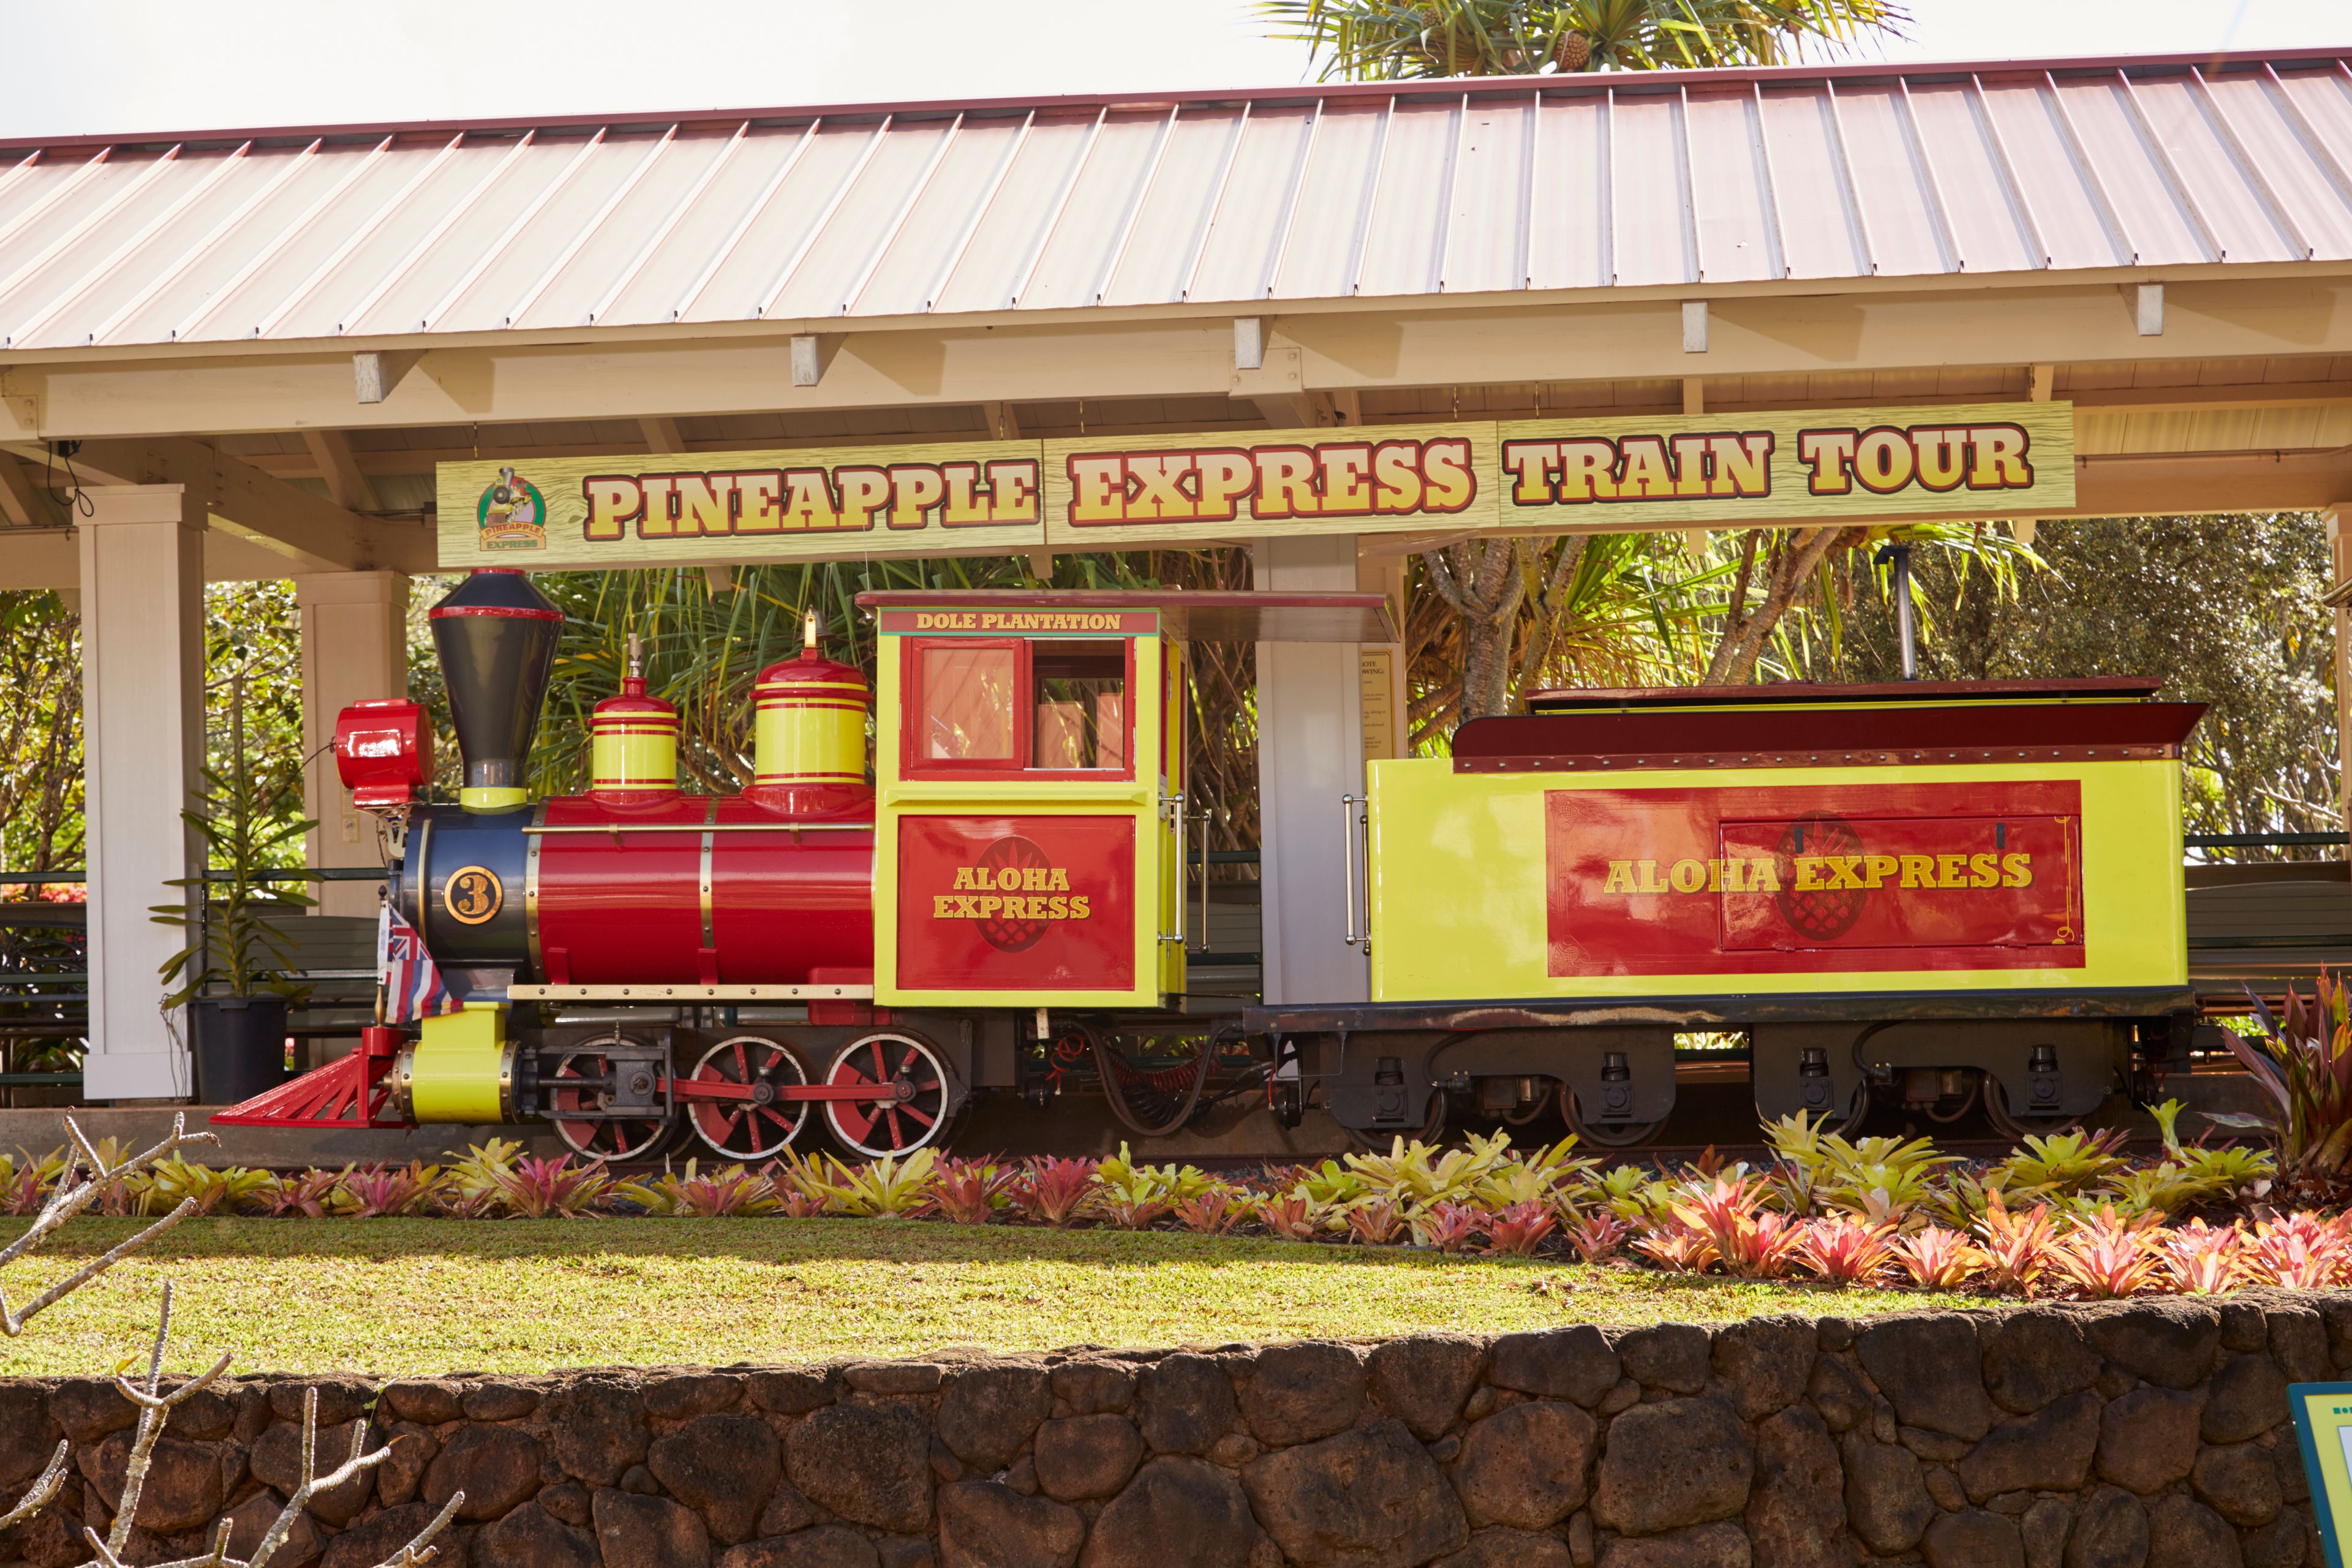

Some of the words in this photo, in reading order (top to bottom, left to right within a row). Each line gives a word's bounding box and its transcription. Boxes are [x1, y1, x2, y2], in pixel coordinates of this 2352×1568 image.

[583, 458, 1040, 541] PINEAPPLE
[1066, 437, 1477, 527] EXPRESS
[1501, 430, 1774, 507] TRAIN
[1798, 422, 2034, 496] TOUR
[484, 523, 541, 537] PINEAPPLE
[486, 540, 538, 549] EXPRESS
[917, 613, 976, 630] DOLE
[982, 614, 1121, 630] PLANTATION
[954, 867, 1071, 892] ALOHA
[1603, 857, 1782, 895] ALOHA
[1795, 852, 2034, 892] EXPRESS
[458, 875, 489, 915] 3
[933, 895, 1091, 920] EXPRESS
